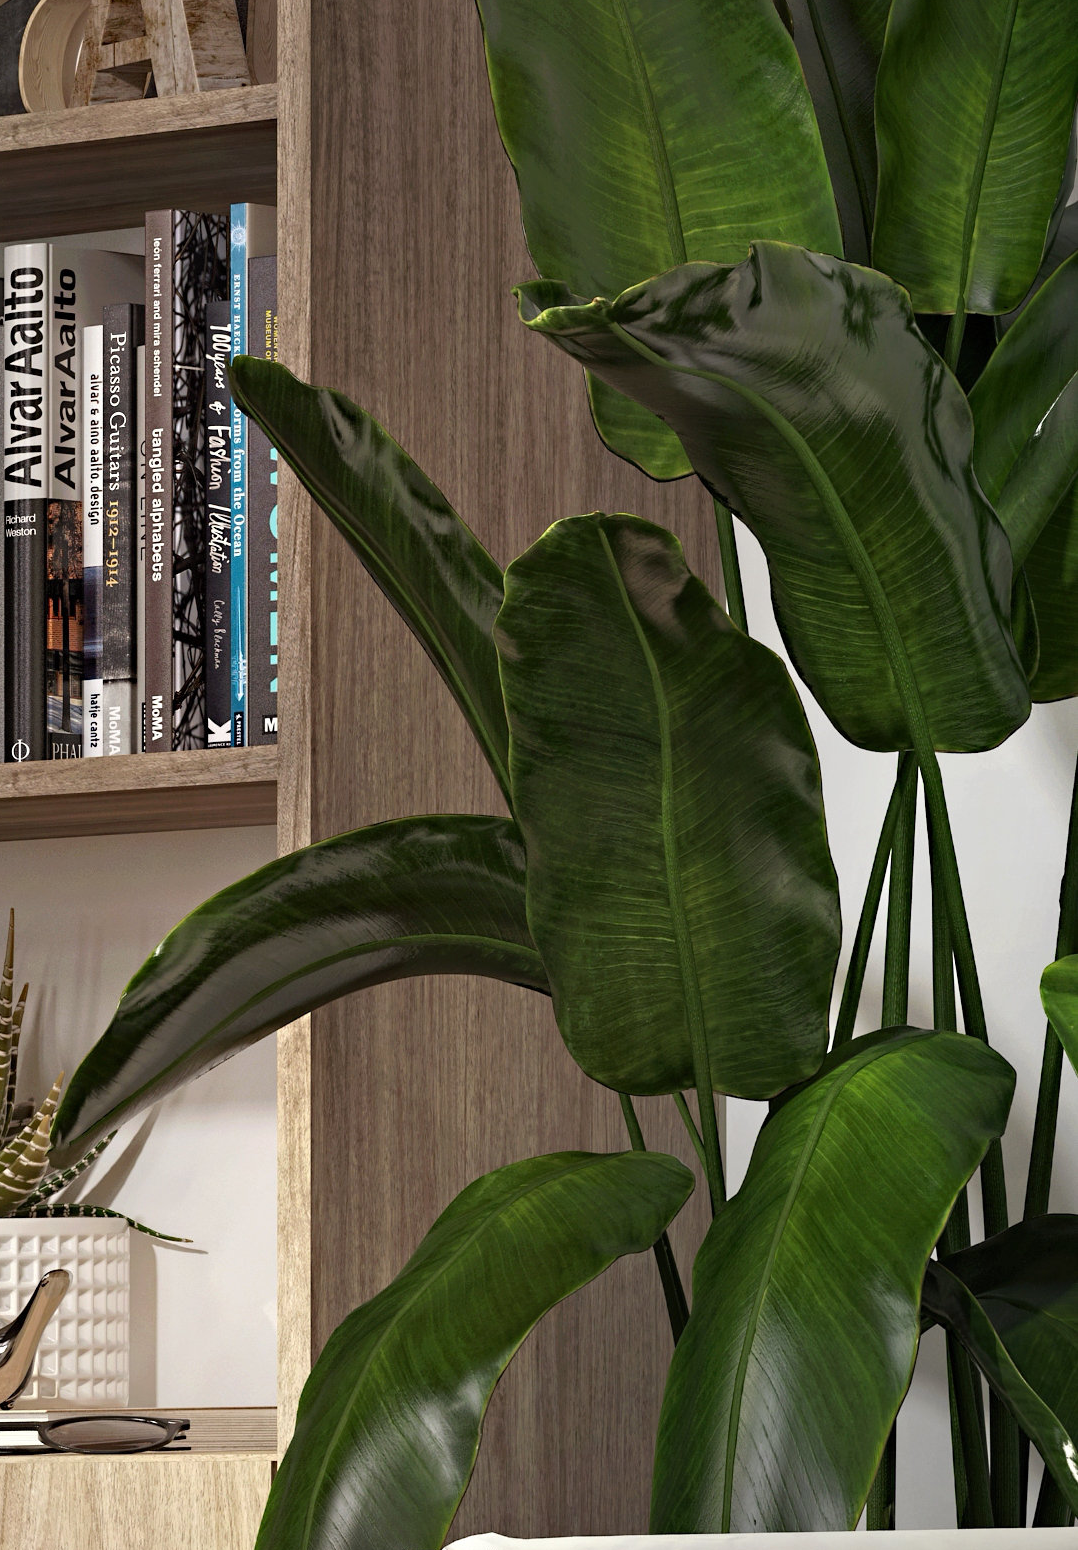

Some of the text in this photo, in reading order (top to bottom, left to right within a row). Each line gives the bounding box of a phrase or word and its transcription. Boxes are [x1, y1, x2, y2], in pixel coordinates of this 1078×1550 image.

[152, 263, 162, 297] ferrari
[152, 299, 162, 320] and
[152, 322, 162, 347] mira
[4, 266, 44, 488] Alvar Aalto
[54, 268, 77, 490] Alvar Aalto
[90, 374, 103, 404] alvar
[109, 331, 127, 407] Picasso
[152, 349, 163, 397] schendel
[90, 419, 99, 446] aino
[233, 273, 245, 558] ERNST from the Ocean
[109, 411, 127, 491] Guitars
[208, 424, 232, 491] Fashion
[5, 513, 36, 526] Richard
[151, 427, 164, 583] tangled alphabets
[5, 526, 37, 538] Weston
[208, 503, 232, 575] Illustration
[88, 693, 101, 749] hatje cantz
[108, 705, 121, 756] MoMA
[151, 695, 163, 742] MoMA
